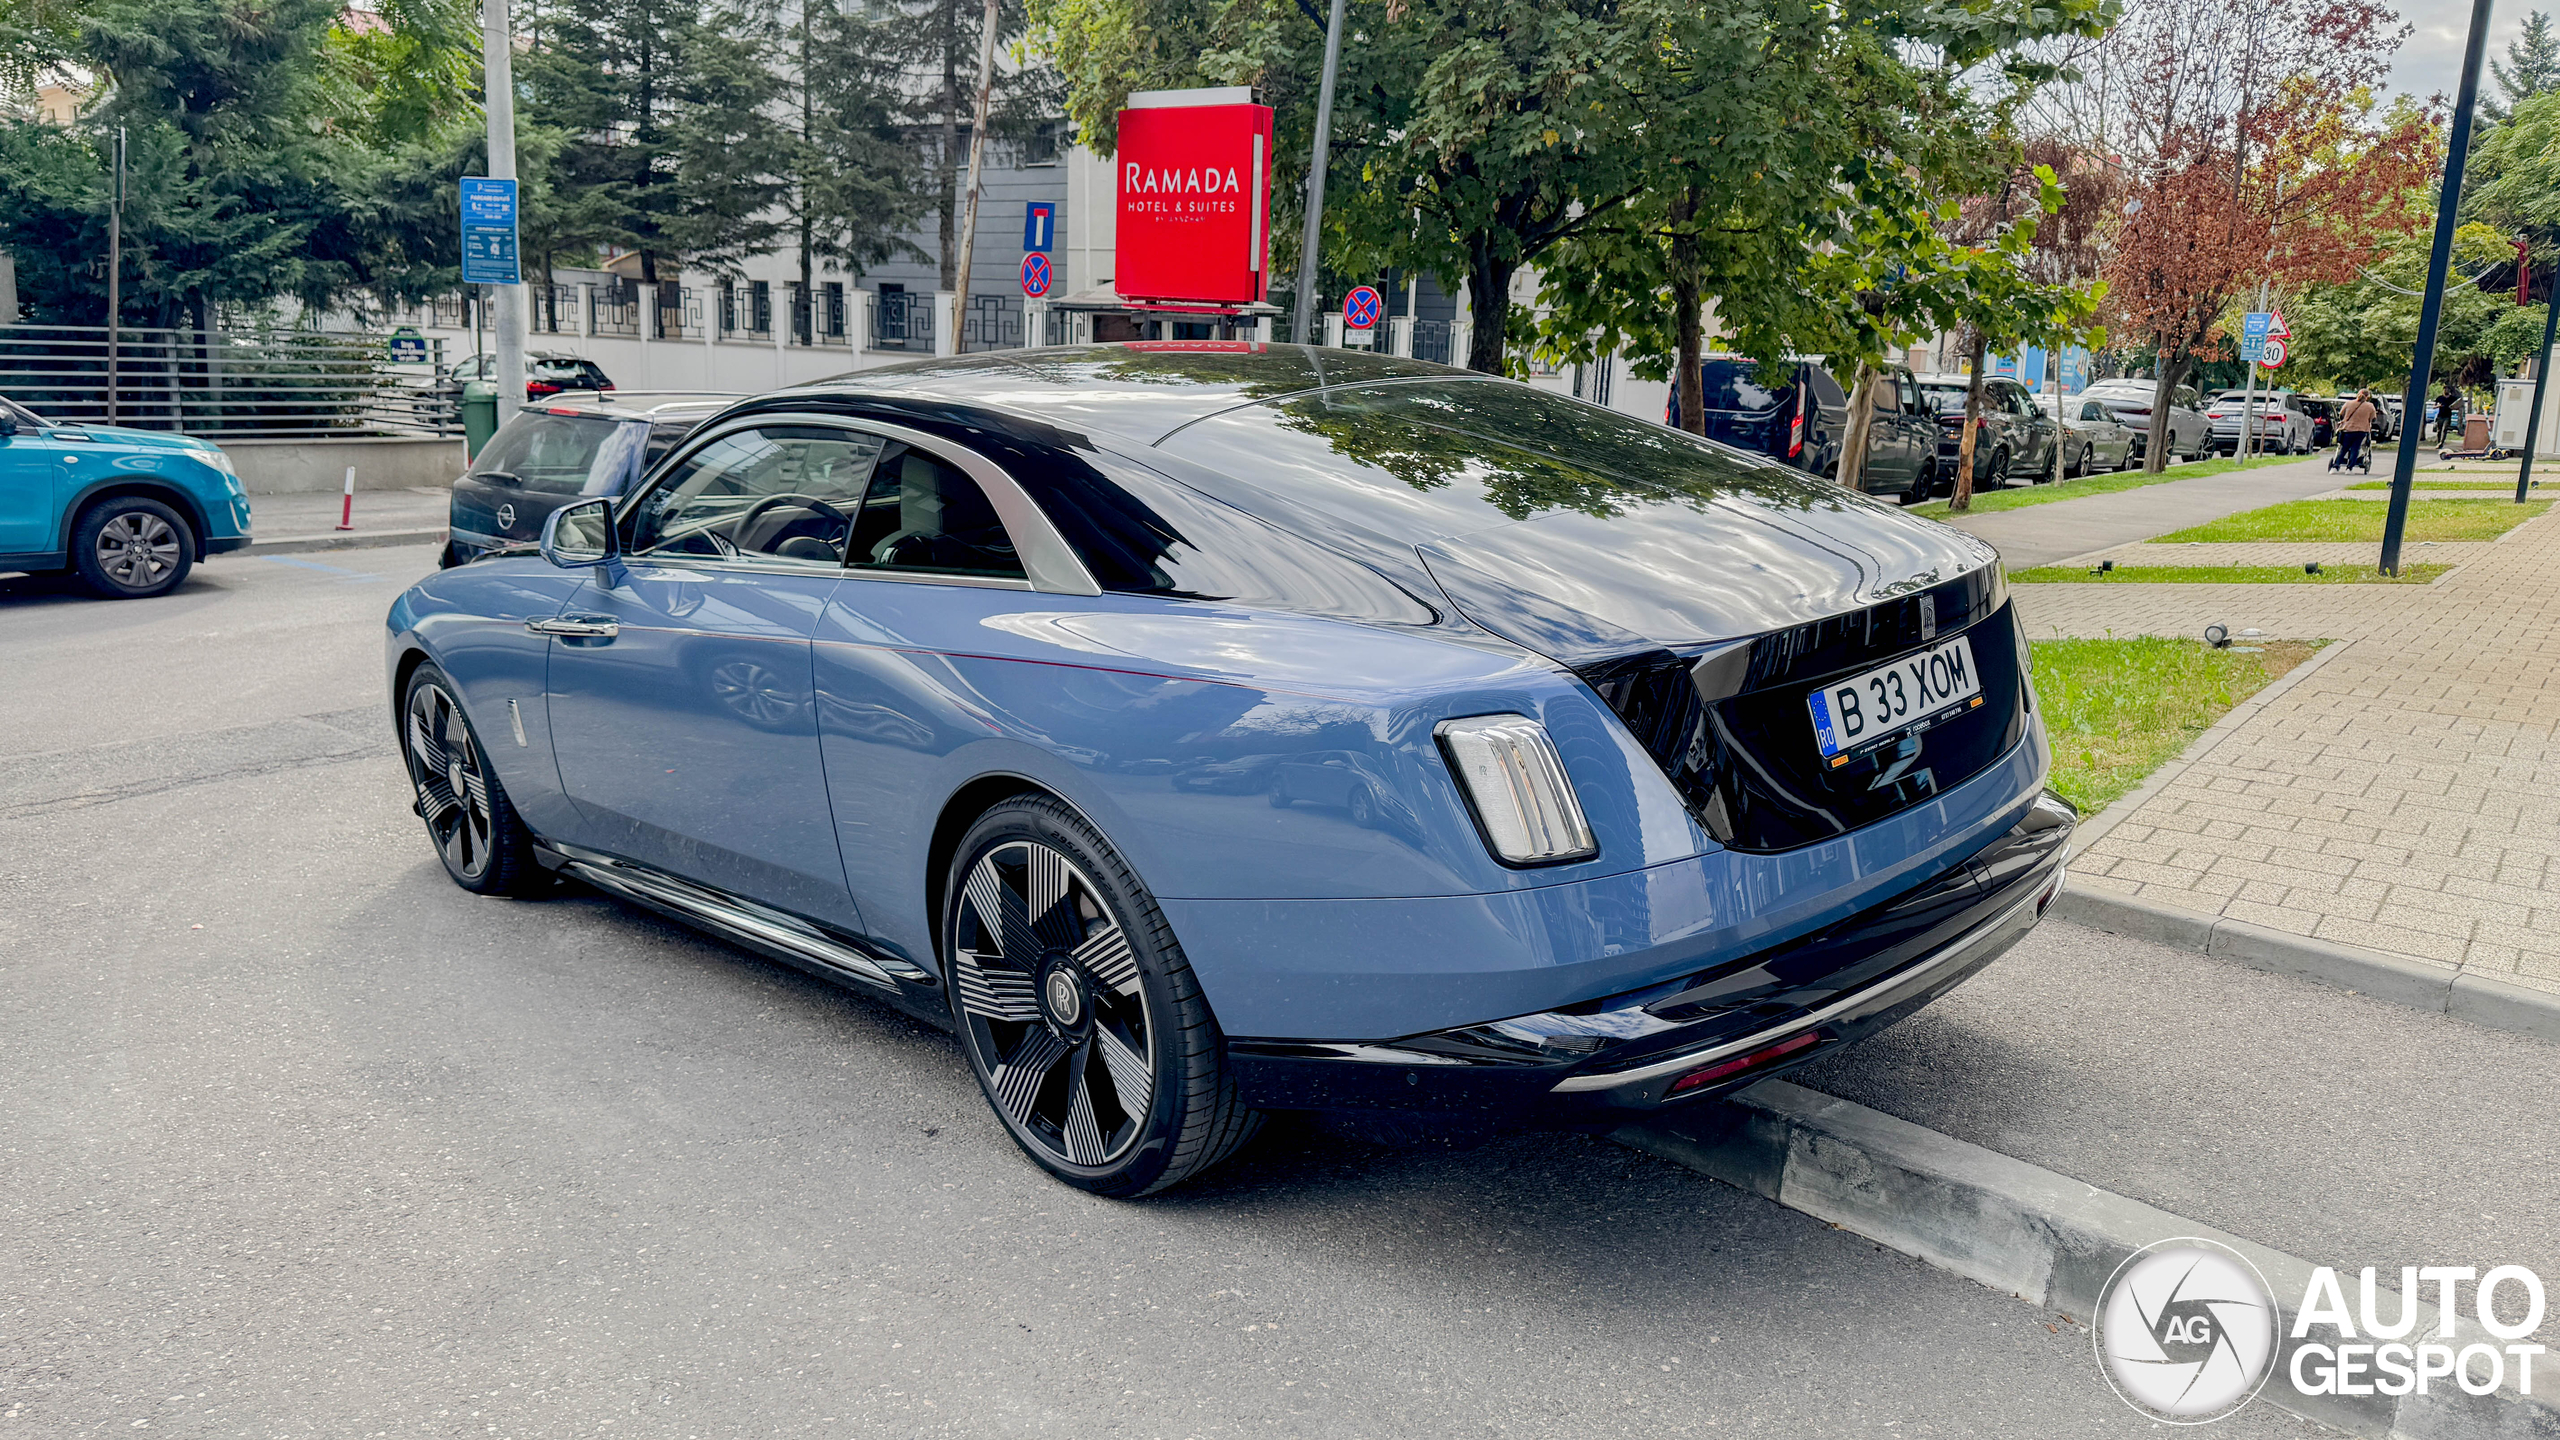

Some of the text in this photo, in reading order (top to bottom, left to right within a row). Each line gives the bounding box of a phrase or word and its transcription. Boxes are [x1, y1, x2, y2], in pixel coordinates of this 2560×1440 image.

[1126, 162, 1239, 193] RAMADA
[1128, 201, 1235, 212] HOTEL & SUITES
[2263, 347, 2280, 361] 30
[1837, 645, 1970, 738] B 33 XOM
[1819, 726, 1835, 749] RO
[1050, 830, 1095, 869] 295/35
